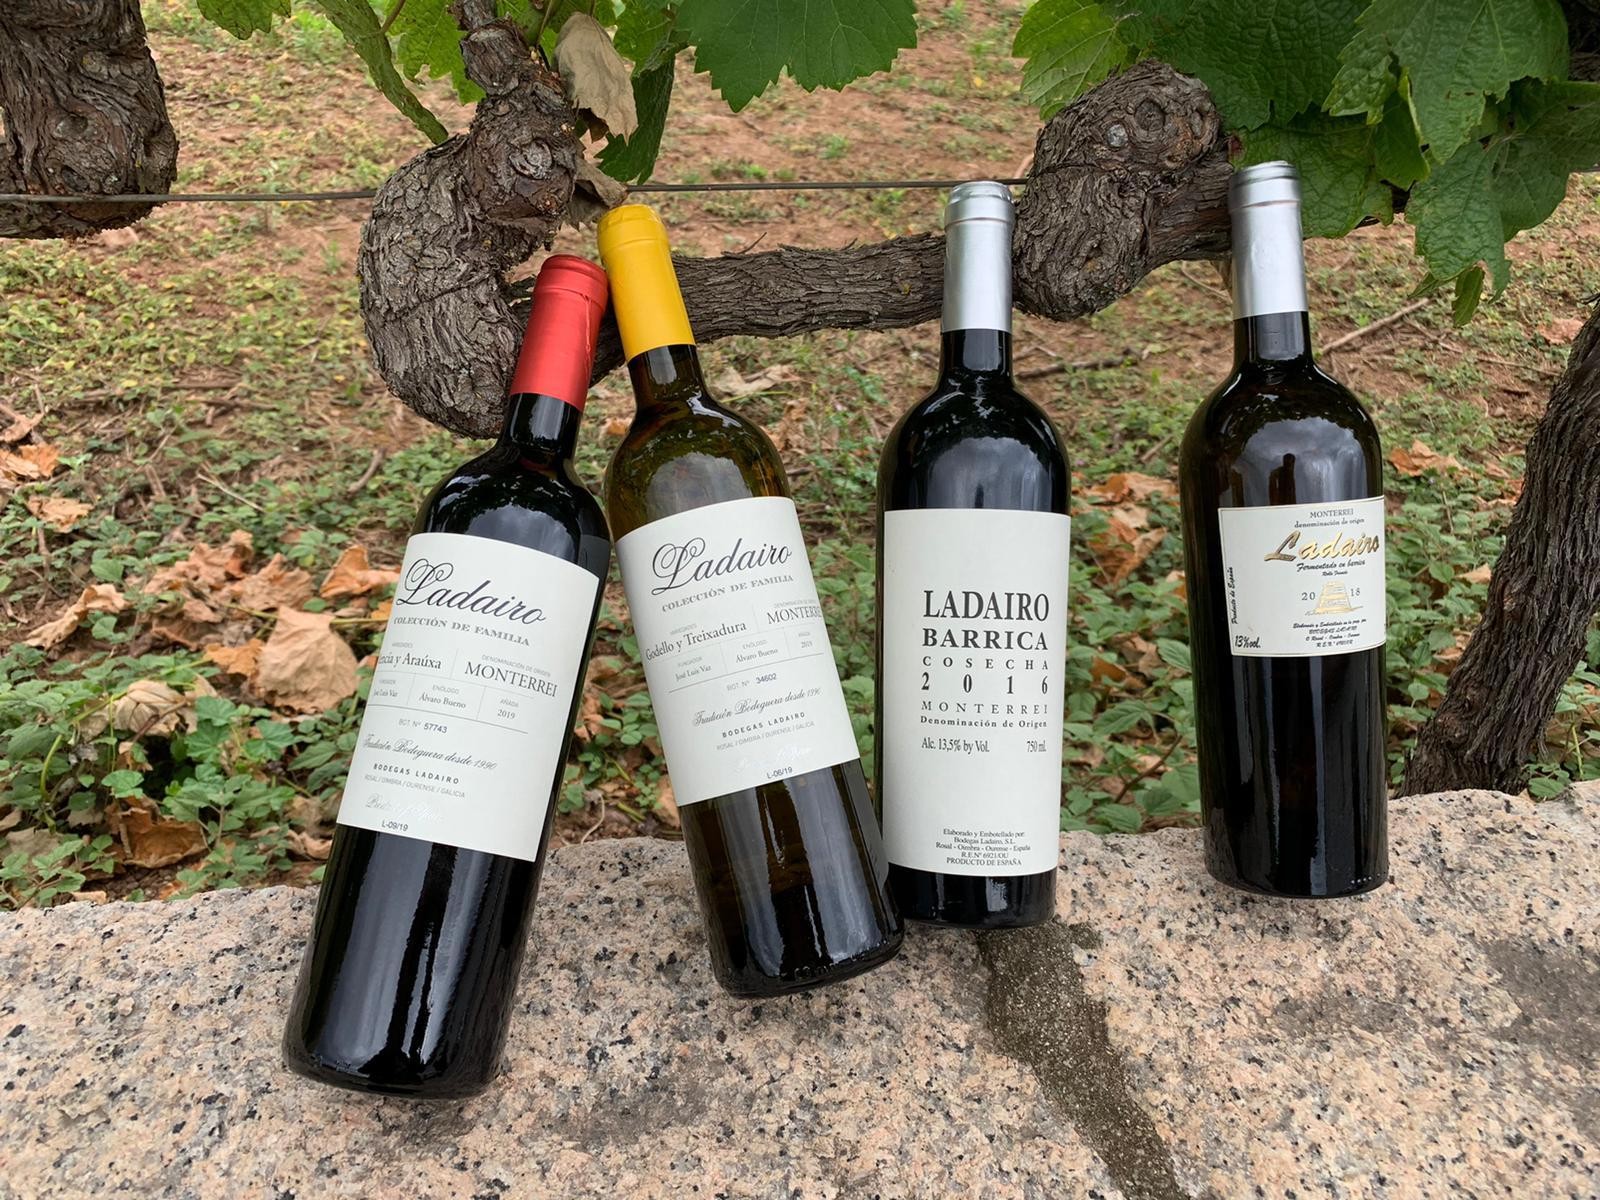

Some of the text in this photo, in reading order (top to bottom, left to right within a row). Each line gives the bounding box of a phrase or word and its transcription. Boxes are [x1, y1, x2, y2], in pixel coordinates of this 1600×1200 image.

[1310, 508, 1354, 518] MONTERREI
[1294, 520, 1340, 528] denominación
[1349, 517, 1365, 525] origen
[1264, 530, 1380, 562] Ladairo
[651, 537, 793, 596] Ladairo
[1296, 561, 1337, 572] Fermentado
[396, 558, 547, 625] Ladairo
[662, 575, 794, 612] COLECCIÓN DE FAMILIA
[1301, 591, 1316, 601] 20
[923, 590, 1050, 621] LADAIRO
[394, 616, 530, 646] COLECCIÓN DE FAMILIA
[922, 628, 1049, 650] BARRICA
[646, 640, 675, 661] Godello
[676, 639, 683, 652] y
[683, 623, 747, 646] Treixadura
[402, 652, 442, 669] Araúxa
[736, 648, 778, 663] Álvaro Bueno
[922, 656, 1048, 670] COSECHA
[464, 661, 558, 697] MONTERREI
[419, 692, 467, 709] Álvaro Bueno
[694, 708, 732, 728] Tradición
[734, 698, 783, 715] Bodeguera
[785, 689, 806, 702] desde
[921, 701, 1048, 714] MONTERREI
[497, 709, 516, 719] 2019
[424, 722, 448, 734] 57743
[722, 712, 806, 738] BODEGAS LADAIRO
[920, 716, 1047, 729] Denominación de Origen
[393, 738, 445, 760] Bodeguera
[445, 752, 473, 766] desde
[474, 760, 498, 770] 1990
[921, 737, 990, 755] Alc. 13,5% by Vol.
[1026, 740, 1037, 753] 750
[373, 763, 460, 784] BODEGAS LADAIRO
[766, 766, 793, 780] L-06/19
[381, 819, 409, 832] L-09/19
[943, 828, 973, 837] Elaborado
[953, 837, 979, 845] Bodegas
[946, 857, 985, 866] PRODUCTO
[997, 858, 1022, 866] ESPAÑA
